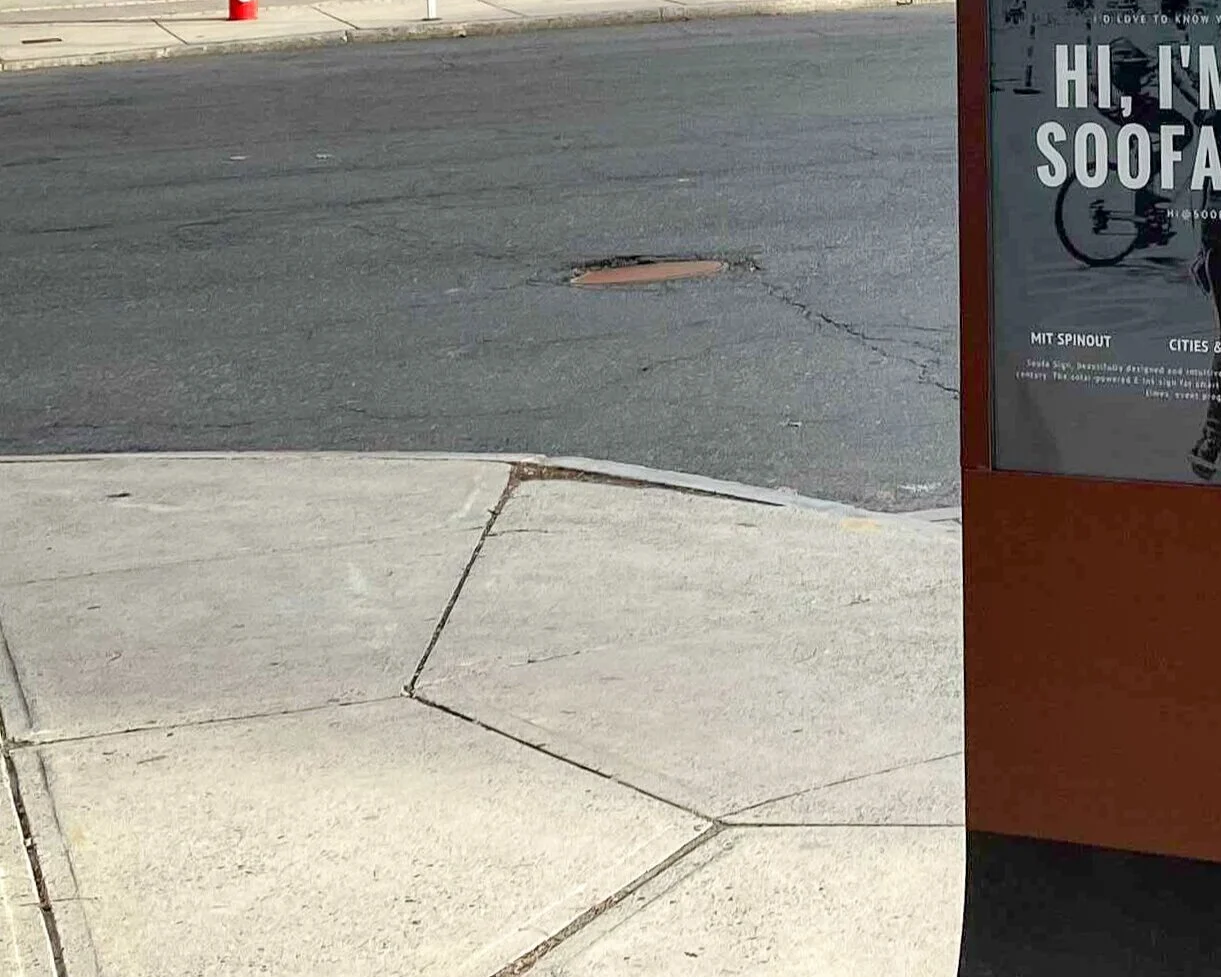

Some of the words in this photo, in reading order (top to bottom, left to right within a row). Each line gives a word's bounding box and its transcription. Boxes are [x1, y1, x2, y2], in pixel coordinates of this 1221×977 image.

[1116, 14, 1147, 24] LOVE
[1153, 14, 1168, 24] TO
[1175, 14, 1210, 24] KNOW
[1055, 44, 1134, 116] HI,
[1030, 332, 1054, 346] MIT
[1057, 333, 1112, 348] SPINOUT
[1169, 338, 1209, 353] CITIES
[1126, 364, 1165, 376] designed
[1167, 366, 1183, 375] and
